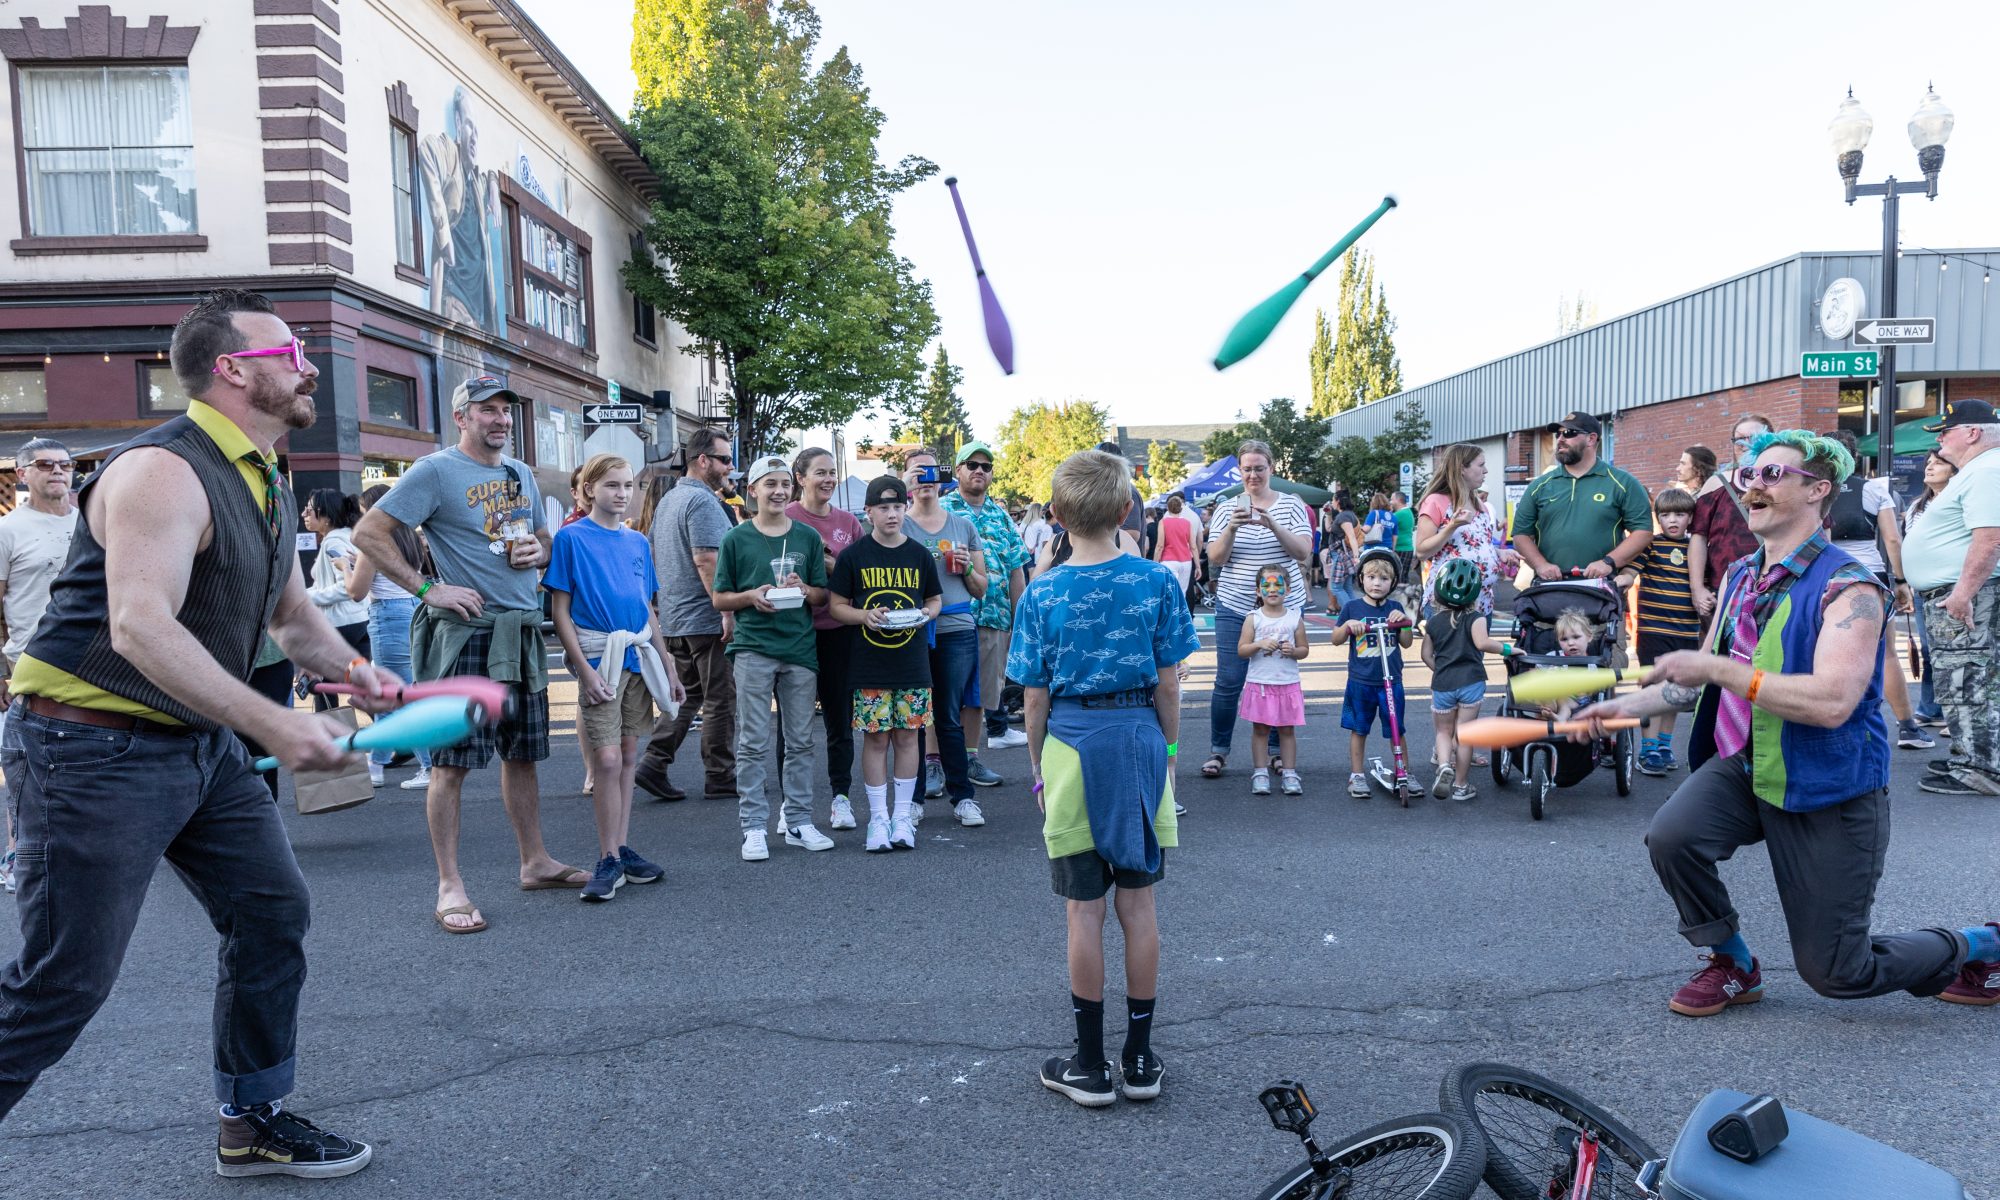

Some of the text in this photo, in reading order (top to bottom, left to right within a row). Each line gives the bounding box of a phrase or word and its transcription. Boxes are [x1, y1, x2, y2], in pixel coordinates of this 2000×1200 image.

[1878, 326, 1926, 337] ONE WAY
[1806, 356, 1873, 373] Main St
[597, 410, 635, 418] ONE WAY
[483, 495, 531, 517] MARIO
[861, 567, 920, 589] NIRVANA
